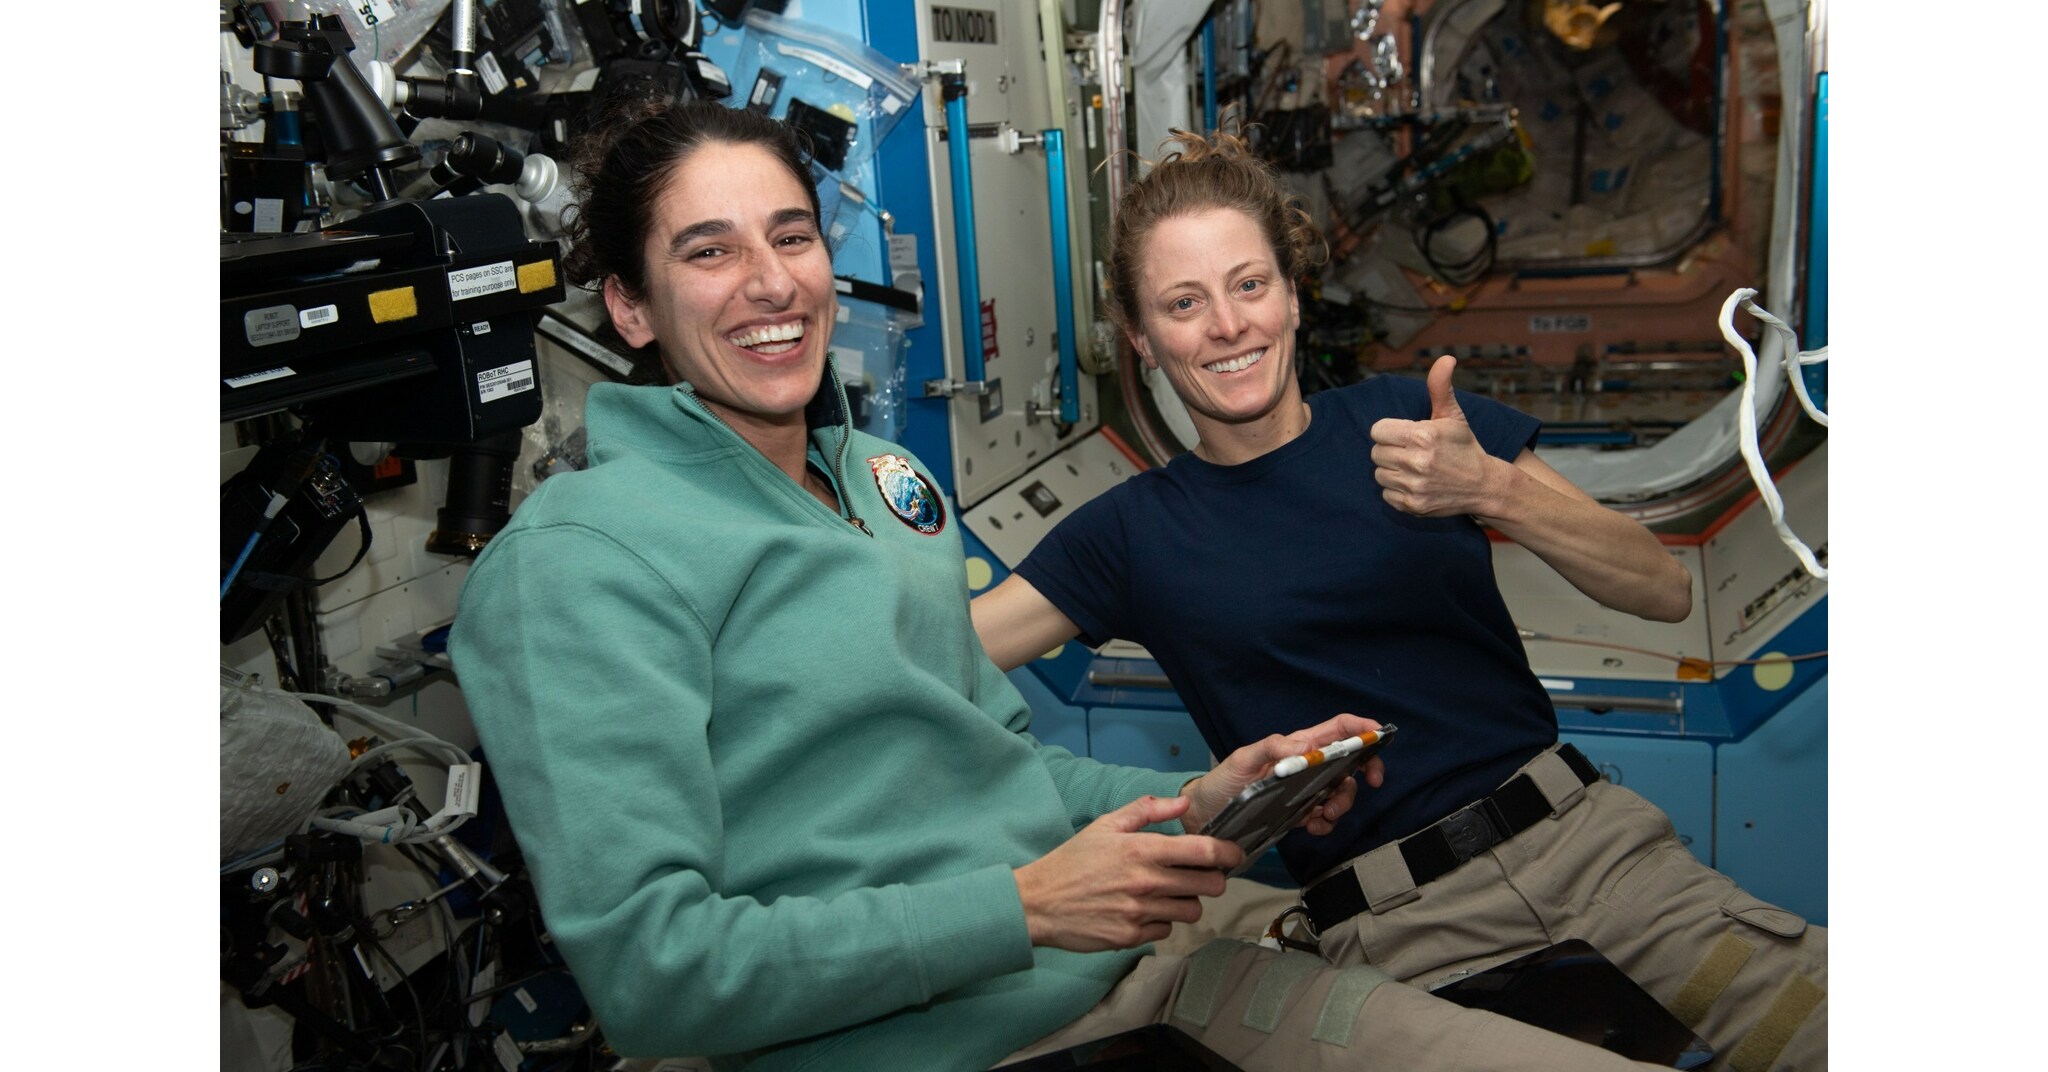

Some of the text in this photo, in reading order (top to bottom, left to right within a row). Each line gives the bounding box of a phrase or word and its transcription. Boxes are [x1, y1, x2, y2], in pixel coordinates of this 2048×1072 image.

[932, 8, 996, 44] TO NOD 1
[451, 273, 464, 283] PCS
[465, 271, 483, 281] pages
[491, 266, 503, 276] SSC
[504, 265, 513, 273] are
[461, 286, 481, 296] training
[482, 281, 503, 293] purpose
[504, 278, 514, 287] only
[474, 324, 489, 332] READY
[497, 367, 509, 376] RHC
